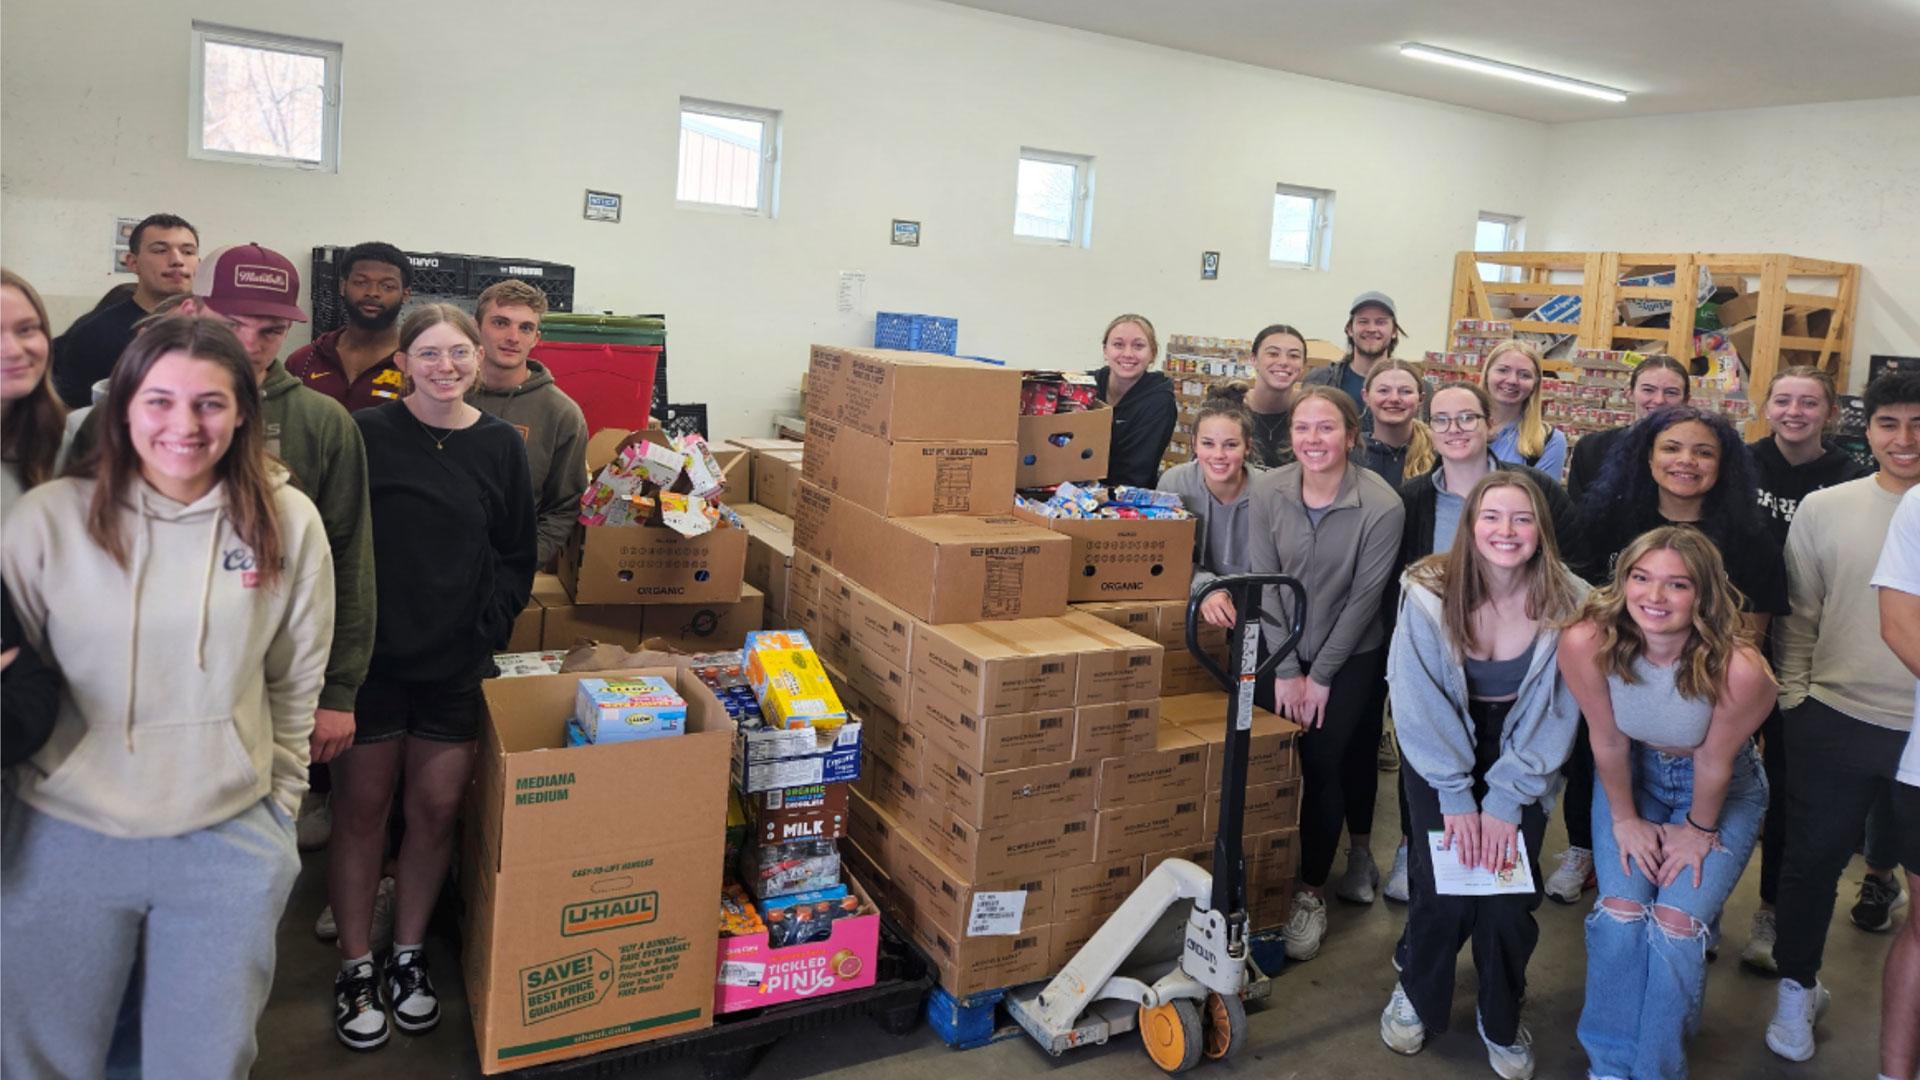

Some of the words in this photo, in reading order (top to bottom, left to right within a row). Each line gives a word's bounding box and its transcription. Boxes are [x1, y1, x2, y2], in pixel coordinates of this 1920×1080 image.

[636, 587, 685, 596] ORGANIC
[1100, 582, 1144, 591] ORGANIC
[516, 772, 576, 790] MEDIANA
[515, 789, 569, 806] MEDIUM
[785, 785, 826, 796] ORGANIC
[785, 799, 824, 809] CHOCOLATE
[783, 820, 825, 838] MILK
[569, 898, 652, 924] U-HAUL
[527, 955, 593, 989] SAVE!
[769, 957, 826, 975] TICKLED
[767, 967, 835, 995] PINK
[528, 989, 558, 1008] BEST
[560, 980, 593, 998] PRICE
[528, 991, 596, 1019] GUARANTEED
[573, 1025, 632, 1042] uhaul.com
